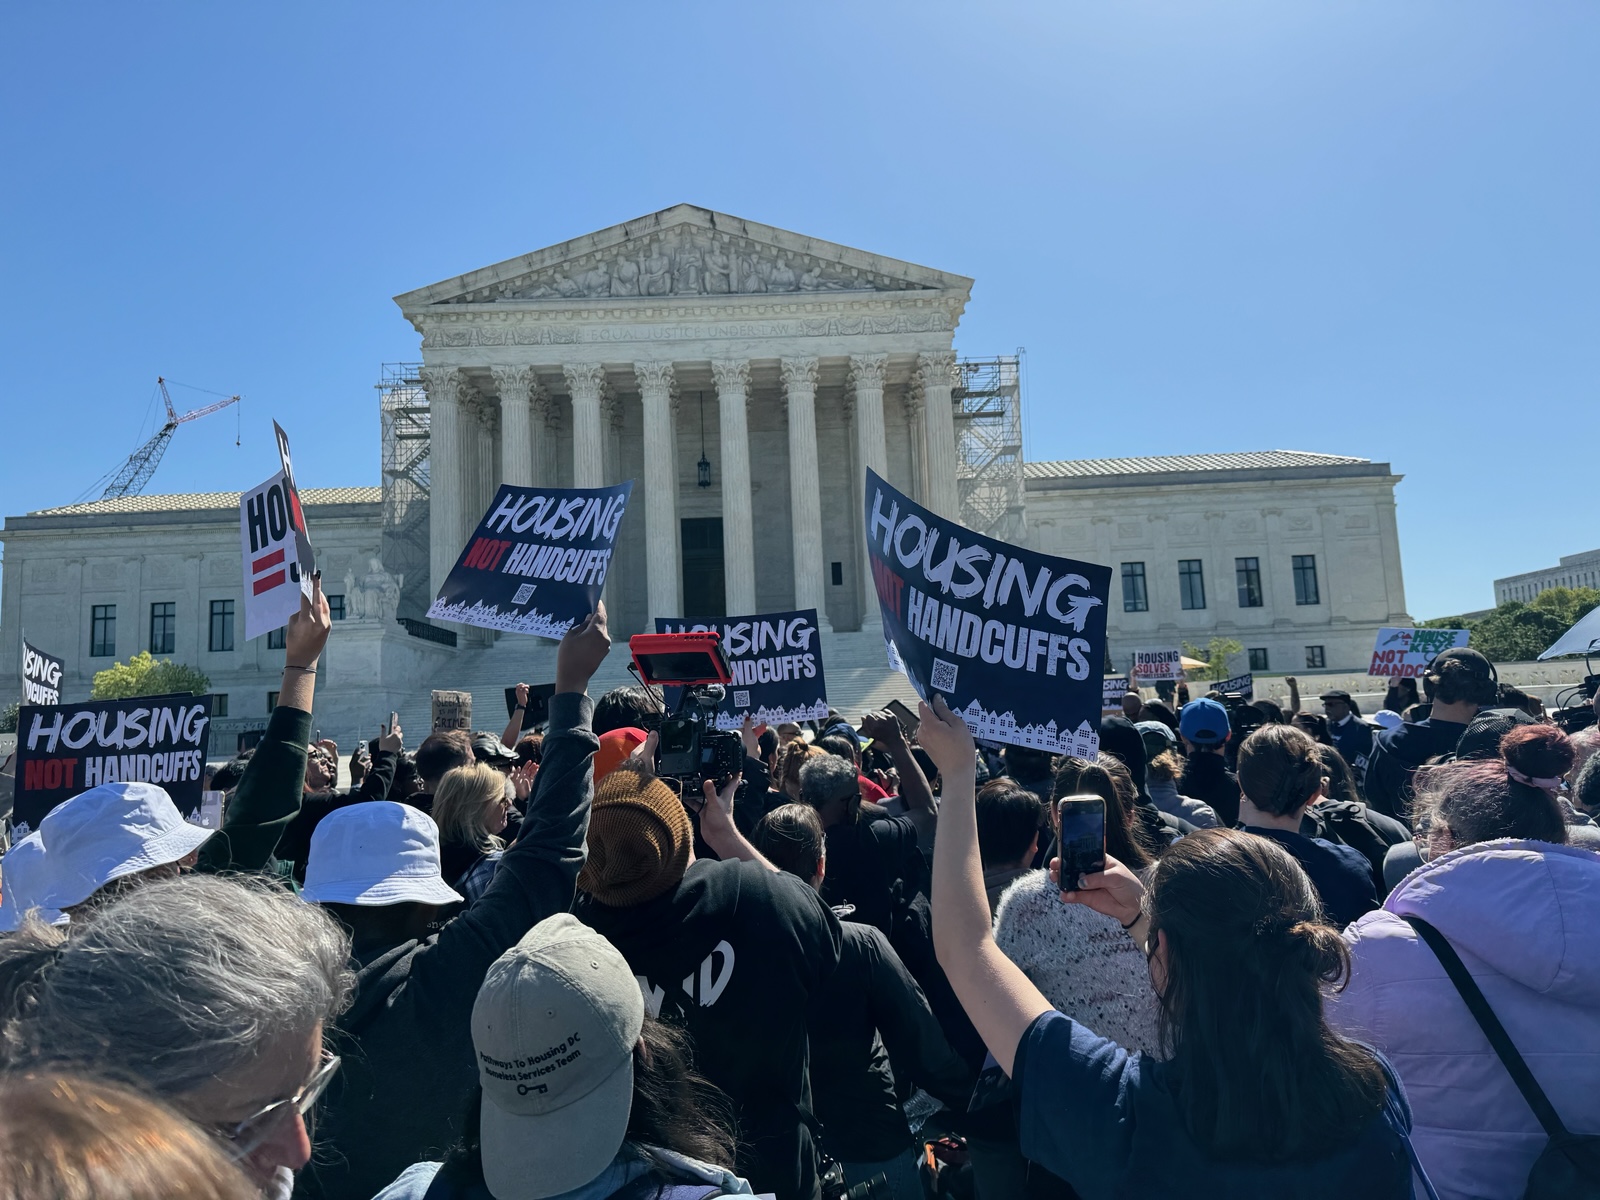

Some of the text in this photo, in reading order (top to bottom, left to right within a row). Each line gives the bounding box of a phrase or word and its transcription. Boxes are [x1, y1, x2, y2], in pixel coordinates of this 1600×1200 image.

[591, 324, 789, 341] EQUAL JUSTICE UNDER LAW
[486, 493, 625, 544] HOUSING
[463, 537, 612, 586] NOT HANDCUFFS
[870, 492, 1103, 633] HOUSING
[665, 618, 816, 657] USING
[907, 585, 1091, 681] HANDCUFFS
[1412, 629, 1458, 644] HOUSE
[23, 642, 63, 689] USING
[713, 653, 817, 686] NDCUFFS
[1137, 650, 1179, 664] HOUSING
[1137, 663, 1170, 674] SOLVES
[1372, 650, 1408, 663] NOT
[27, 704, 209, 753] HOUSING
[24, 750, 202, 791] NOT HANDCUFFS
[480, 1032, 581, 1070] Pathways To Housing DC
[518, 1063, 556, 1081] Services
[555, 1050, 581, 1068] Team
